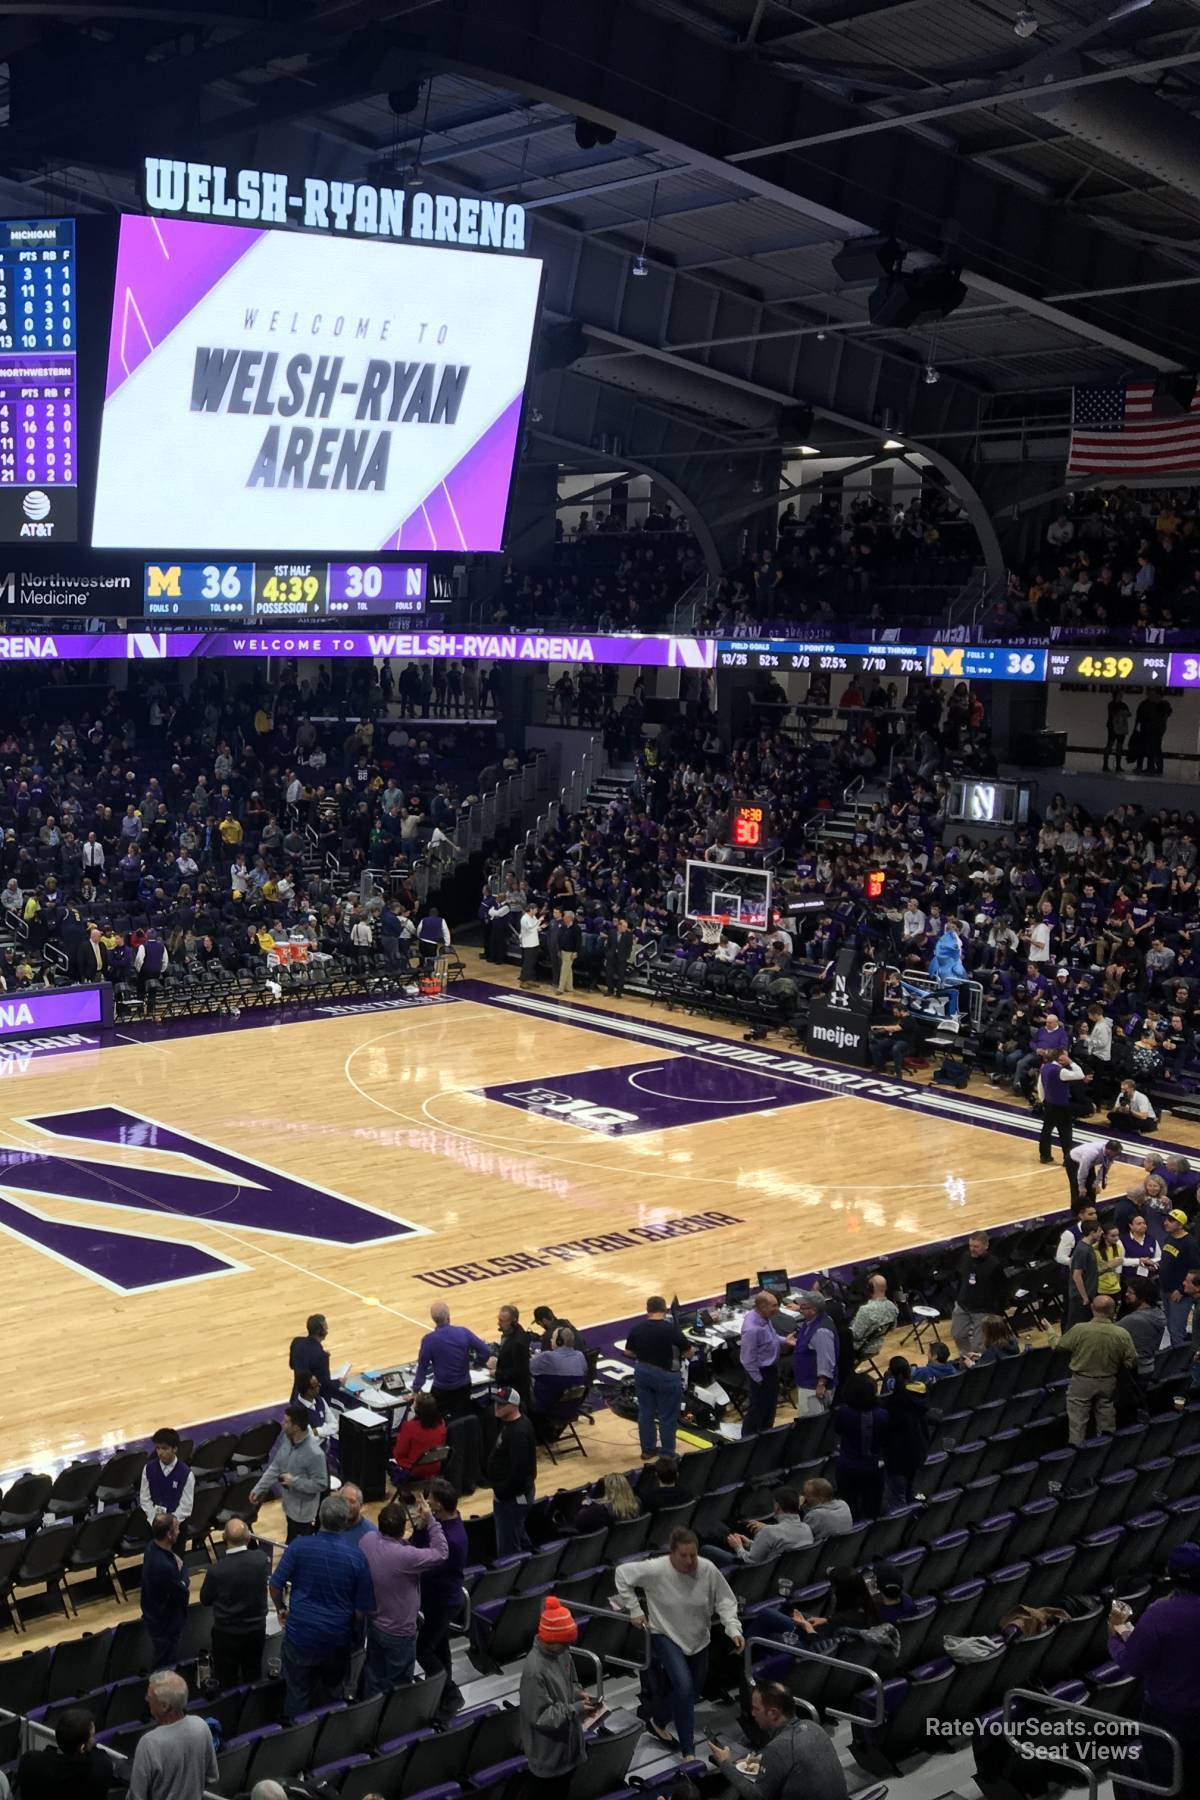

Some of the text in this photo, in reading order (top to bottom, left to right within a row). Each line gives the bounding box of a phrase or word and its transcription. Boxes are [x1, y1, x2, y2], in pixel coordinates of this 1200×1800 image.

[145, 157, 526, 250] WELSH-RYAN ARENA
[11, 230, 56, 240] MICHIGAN
[24, 268, 32, 280] 3
[45, 267, 51, 279] 1
[62, 266, 69, 279] 1
[21, 284, 34, 297] 11
[45, 284, 52, 296] 1
[63, 283, 70, 296] 0
[243, 308, 448, 345] WELCOME TO
[0, 334, 71, 348] 13 10 1 0
[0, 368, 71, 377] NORTHWESTERN
[190, 347, 471, 425] WELSH-RYAN
[245, 425, 392, 491] ARENA
[20, 524, 54, 537] AT&T
[274, 565, 311, 577] 1ST HALF
[20, 573, 130, 588] Northwestern
[148, 566, 241, 599] M 36
[345, 566, 382, 598] 30
[406, 568, 421, 595] N
[263, 577, 319, 601] 4:39
[150, 604, 169, 613] FOULS
[257, 602, 308, 614] POSSESSION
[395, 602, 413, 611] FOULS
[233, 639, 321, 651] WELCOME
[333, 639, 355, 651] TO
[368, 635, 518, 658] WELSH-RYAN
[519, 638, 594, 661] ARENA
[887, 647, 917, 655] THROWS
[967, 651, 985, 659] FOULS
[722, 653, 779, 667] 13/25 52%
[791, 656, 847, 670] 3/8 37.5%
[862, 658, 923, 672] 7/10 70%
[930, 648, 964, 675] M
[1007, 654, 1036, 674] 36
[1051, 655, 1070, 665] HALF
[1077, 656, 1135, 678] 4:39
[1143, 658, 1167, 668] POSS.
[1052, 666, 1065, 675] 1ST
[1182, 659, 1200, 681] 3
[973, 785, 995, 820] N
[736, 819, 760, 845] 30
[835, 975, 846, 992] N
[812, 1024, 860, 1048] meijer
[696, 1043, 918, 1097] WILDCATS
[412, 1210, 747, 1289] WELSH-RYAN ARENA
